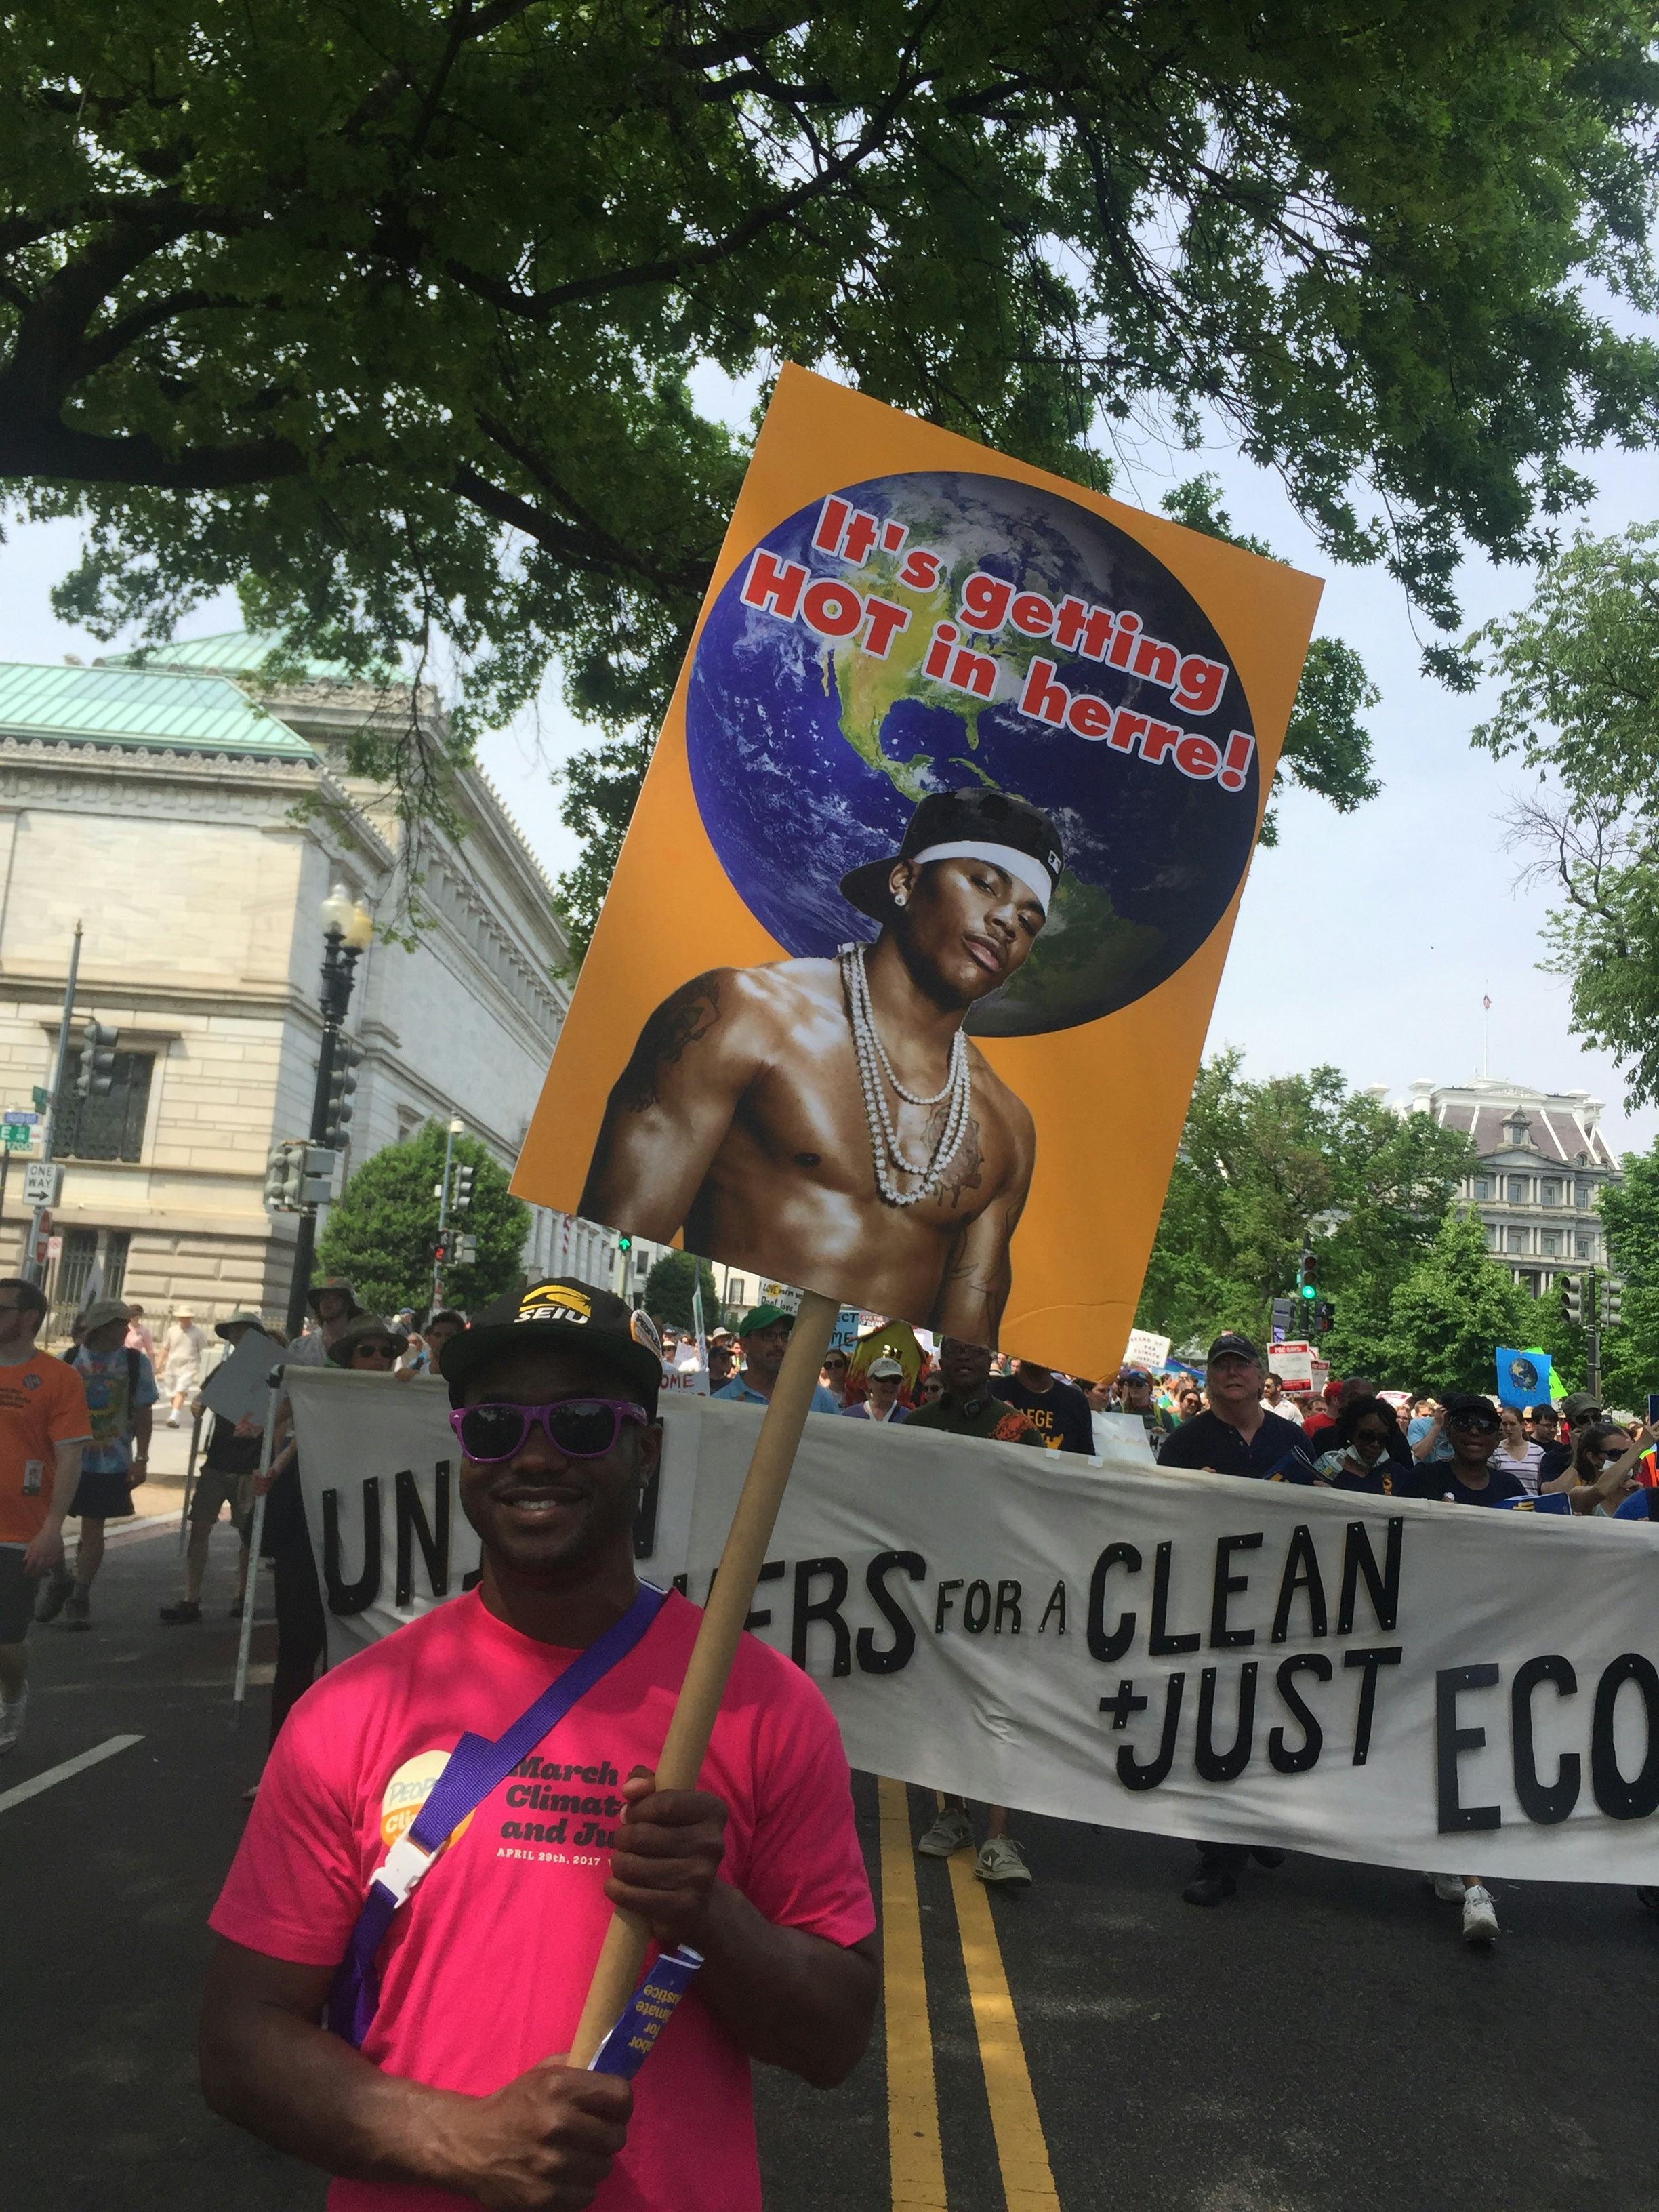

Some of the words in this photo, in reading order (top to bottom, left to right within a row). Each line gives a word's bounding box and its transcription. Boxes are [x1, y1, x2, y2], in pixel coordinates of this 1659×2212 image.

[811, 493, 943, 595] It's
[955, 571, 1229, 716] getting
[739, 548, 910, 660] HOT
[921, 619, 1000, 701] in
[1017, 655, 1255, 792] herre!
[28, 1178, 53, 1189] WAY
[30, 1165, 53, 1177] ONE
[763, 1282, 779, 1294] LOVE
[514, 1307, 589, 1324] SEIU
[660, 1372, 695, 1390] OME
[935, 1578, 1023, 1633] FOR
[1038, 1579, 1066, 1635] A
[1086, 1517, 1404, 1662] CLEAN
[512, 1756, 618, 1786] March
[388, 1777, 438, 1807] PEOP
[506, 1784, 621, 1818] Climat
[500, 1819, 567, 1845] and
[496, 1847, 535, 1860] APRIL
[537, 1852, 570, 1865] 29th,
[573, 1856, 601, 1866] 2017
